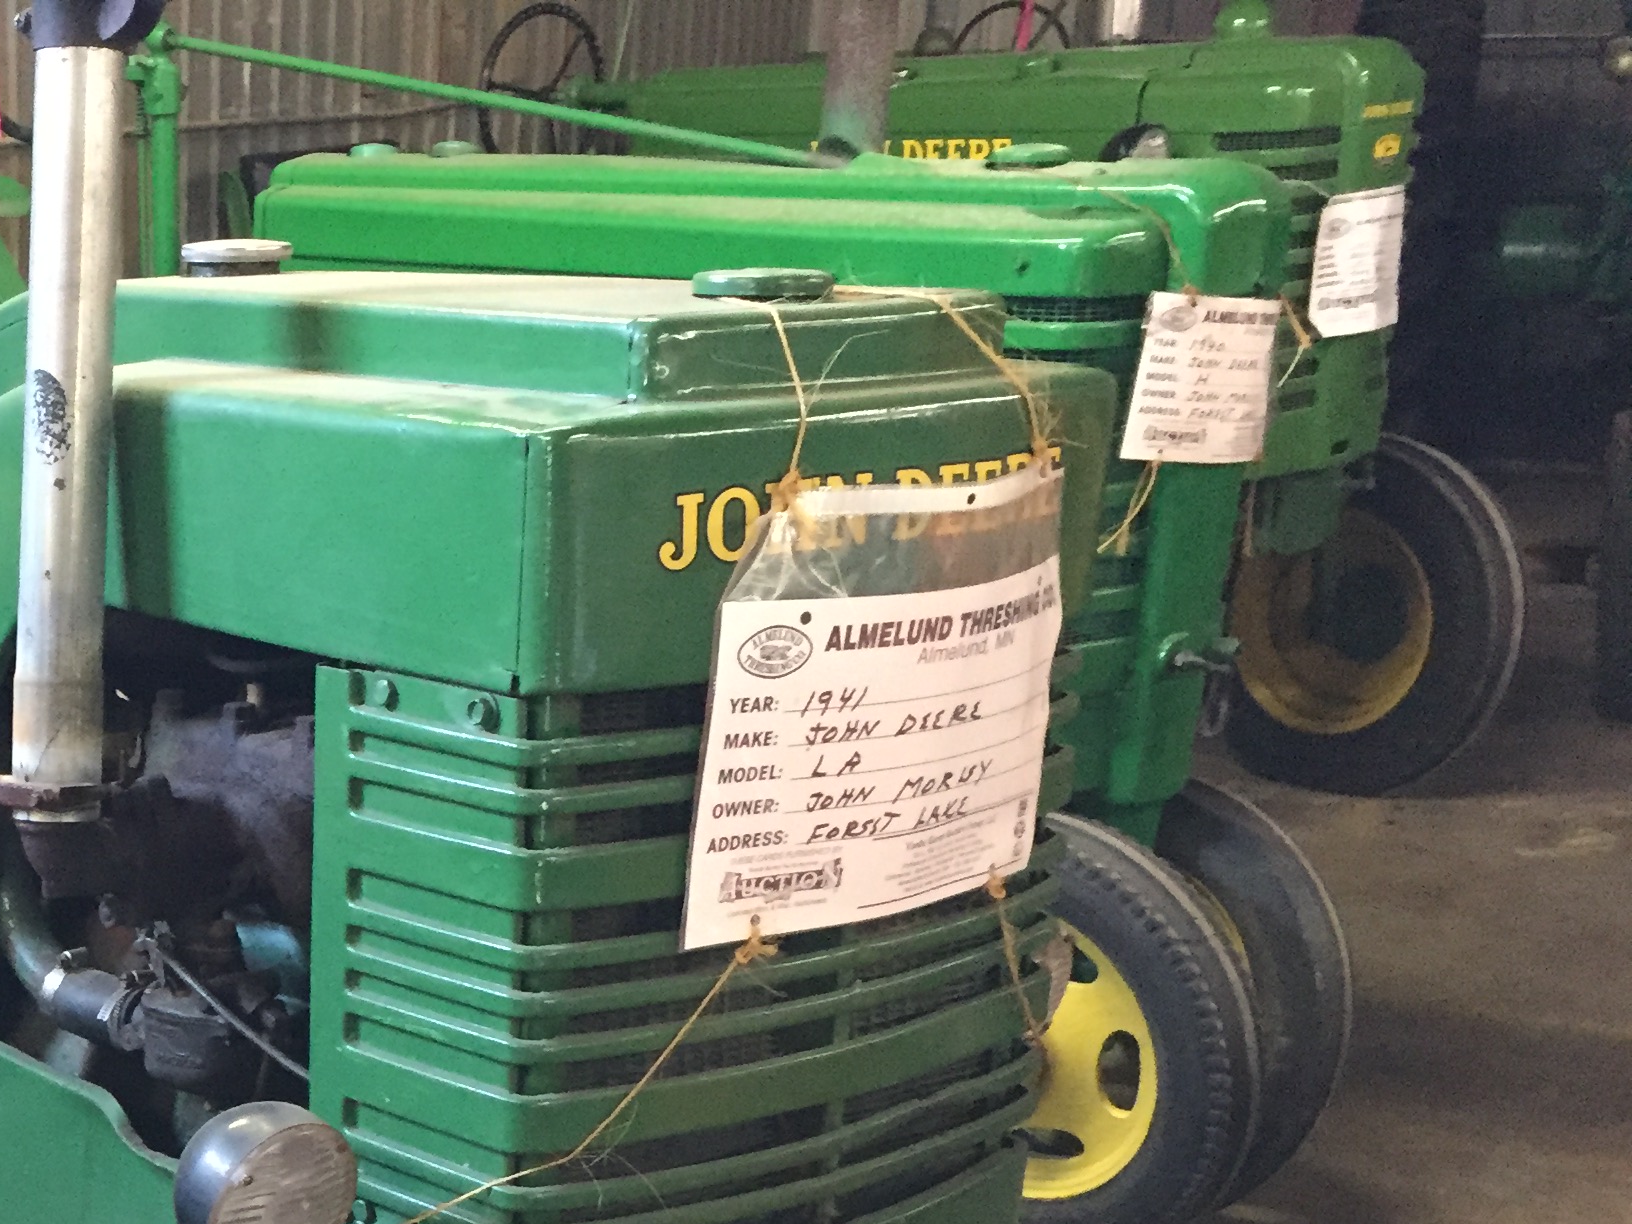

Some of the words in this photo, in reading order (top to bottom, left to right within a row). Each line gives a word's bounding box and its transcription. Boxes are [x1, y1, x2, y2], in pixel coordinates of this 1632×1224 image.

[824, 616, 953, 652] ALMELUND
[729, 696, 778, 714] YEAR:
[801, 687, 869, 718] 1941
[723, 731, 777, 750] MAKE:
[805, 720, 880, 747] JOHN
[895, 701, 982, 738] DEERE
[718, 767, 783, 784] MODEL:
[712, 800, 779, 819] OWNER:
[806, 786, 875, 813] JOHN
[706, 830, 789, 853] ADDRESS:
[914, 797, 969, 829] LAKE
